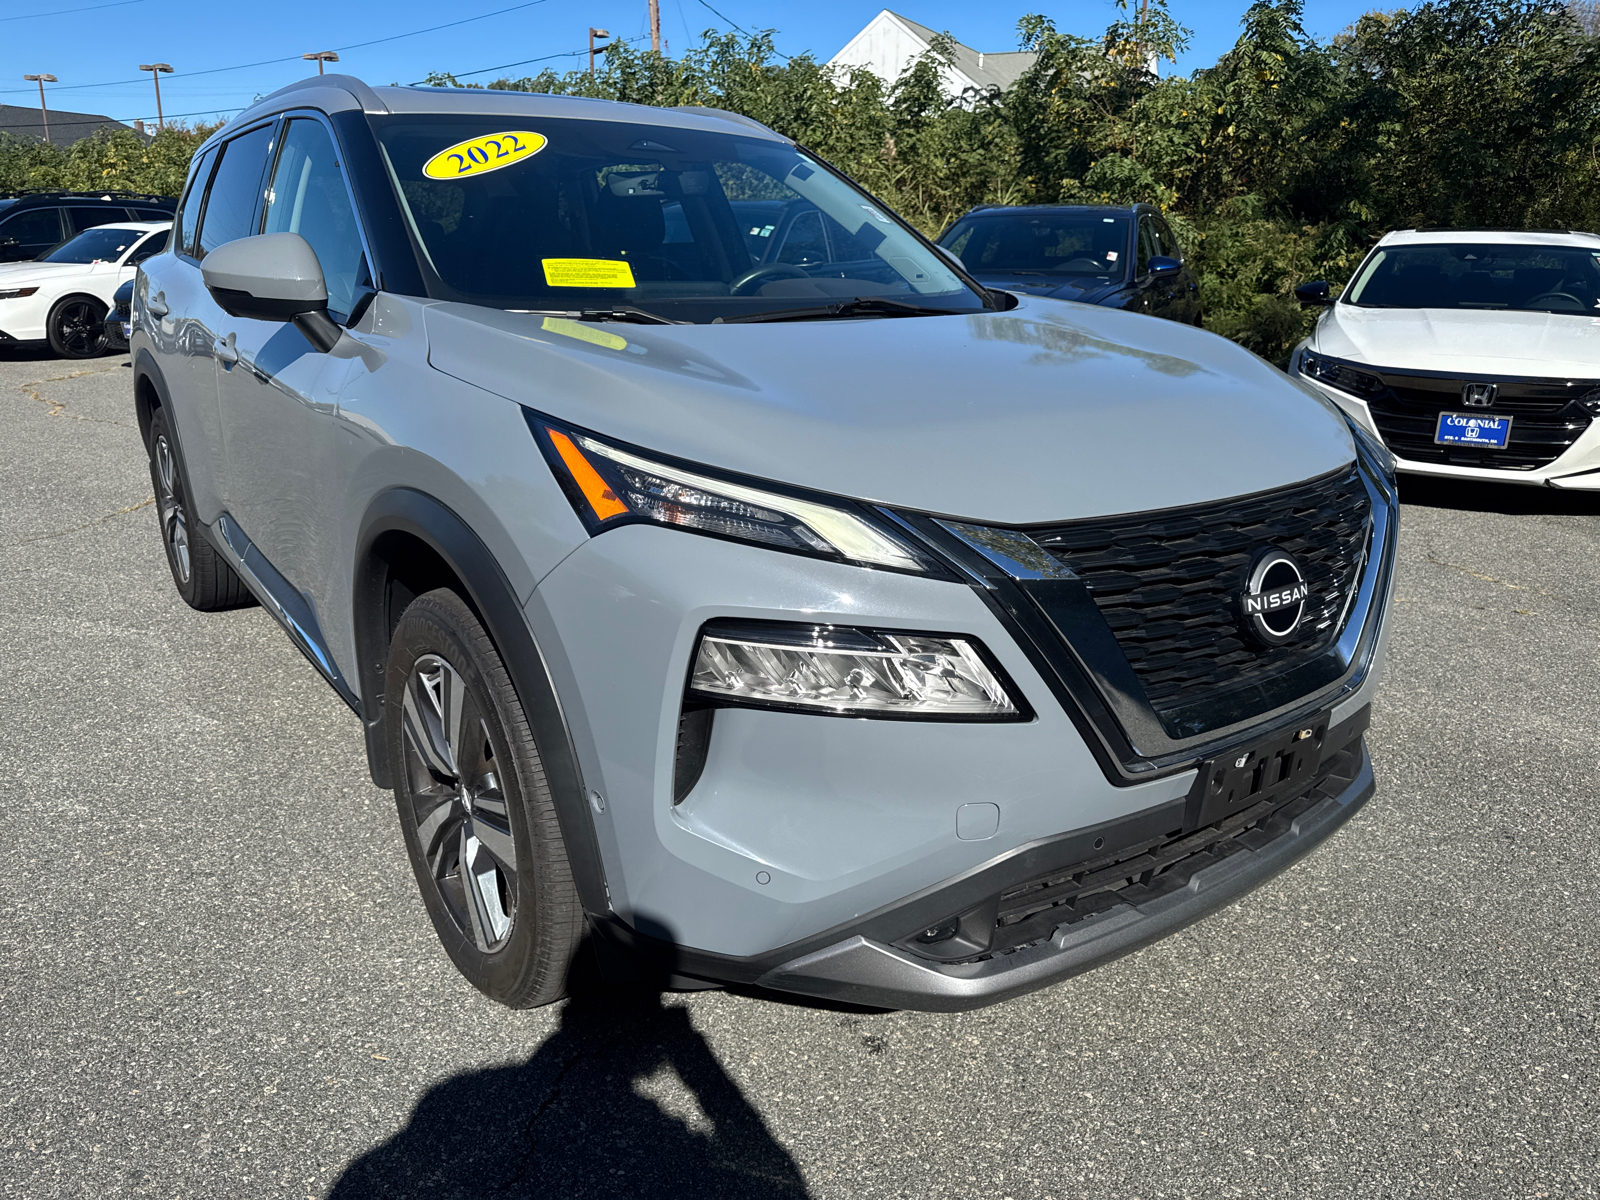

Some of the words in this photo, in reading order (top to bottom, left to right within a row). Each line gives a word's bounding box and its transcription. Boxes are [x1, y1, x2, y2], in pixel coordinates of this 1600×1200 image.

[447, 135, 527, 173] 2022
[1447, 417, 1502, 429] COLONIAL
[1247, 582, 1308, 612] NISSAN
[404, 616, 475, 683] BRIDGESTONE
